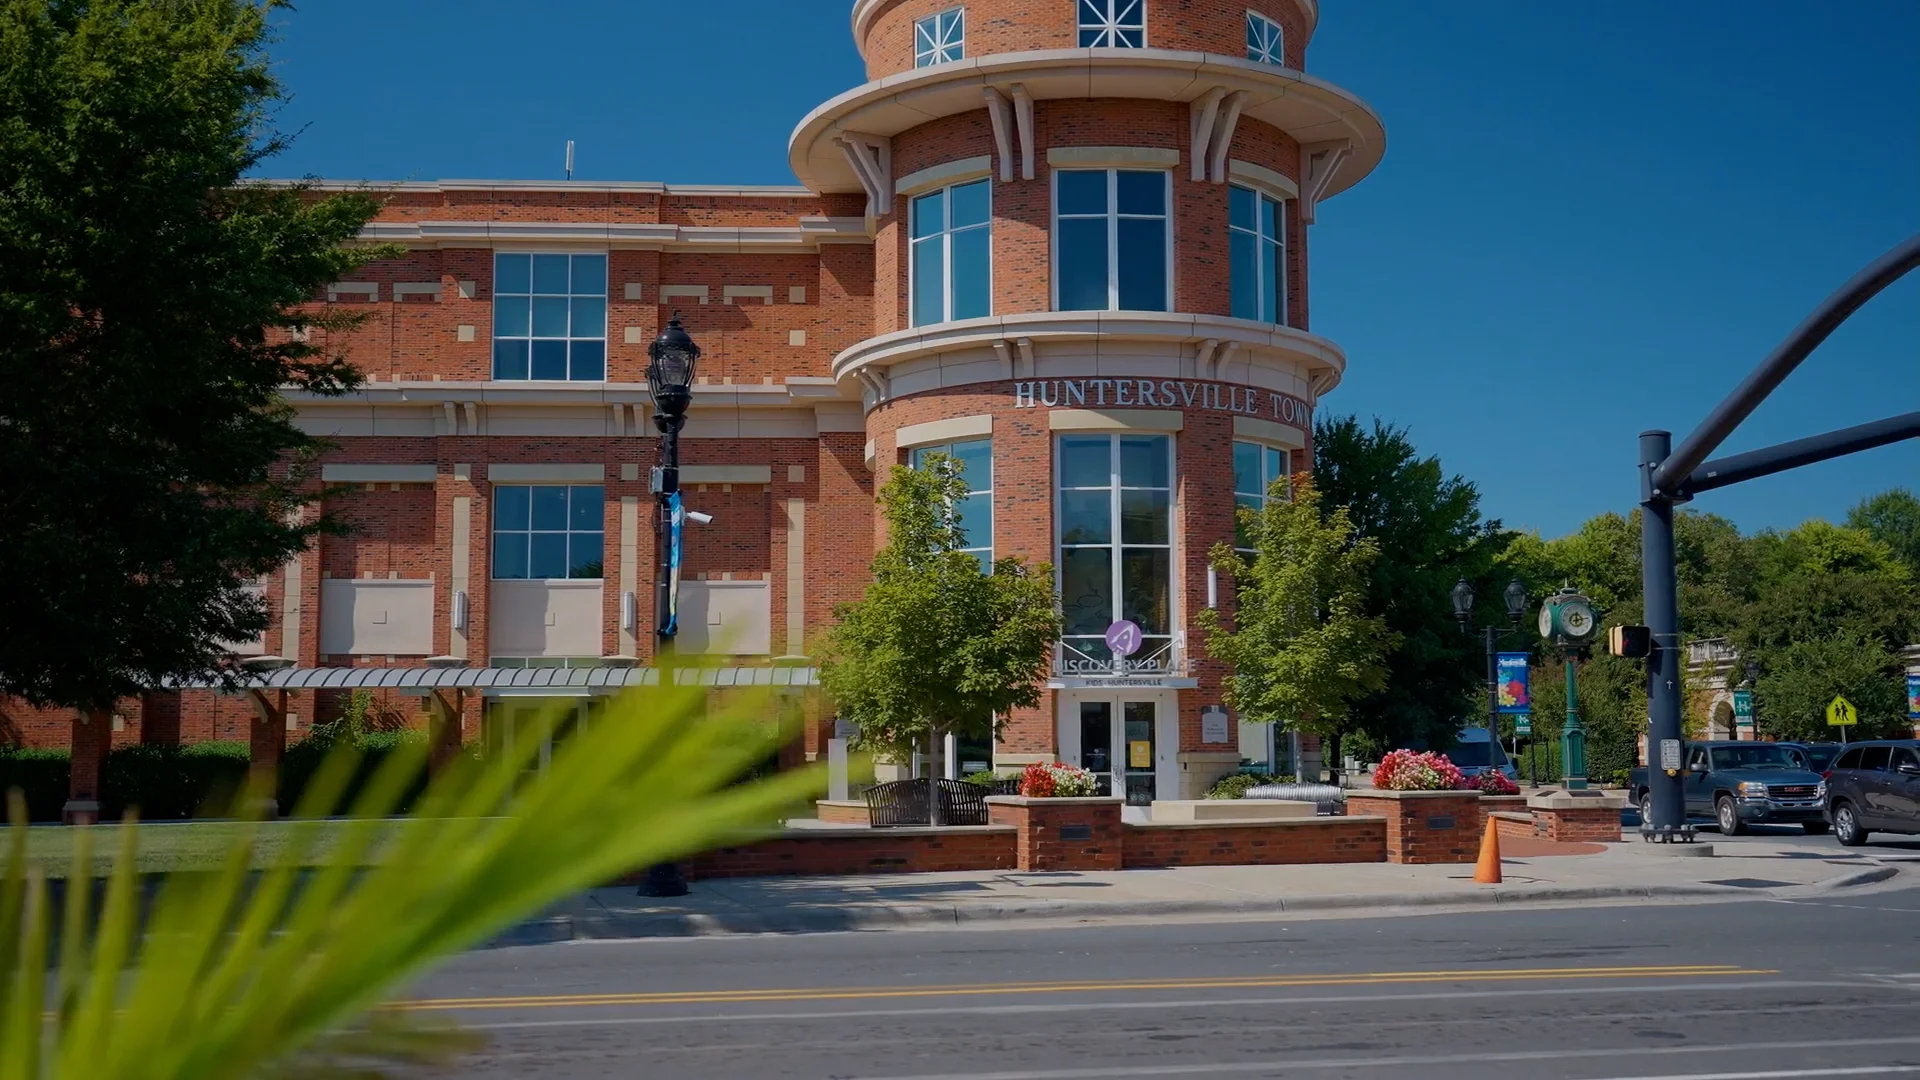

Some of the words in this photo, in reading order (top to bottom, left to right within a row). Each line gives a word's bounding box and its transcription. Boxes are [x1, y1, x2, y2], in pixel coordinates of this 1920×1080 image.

[1014, 379, 1258, 414] HUNTERSVILLE
[1269, 393, 1311, 430] TOWN
[1052, 659, 1142, 673] DISCOVERY
